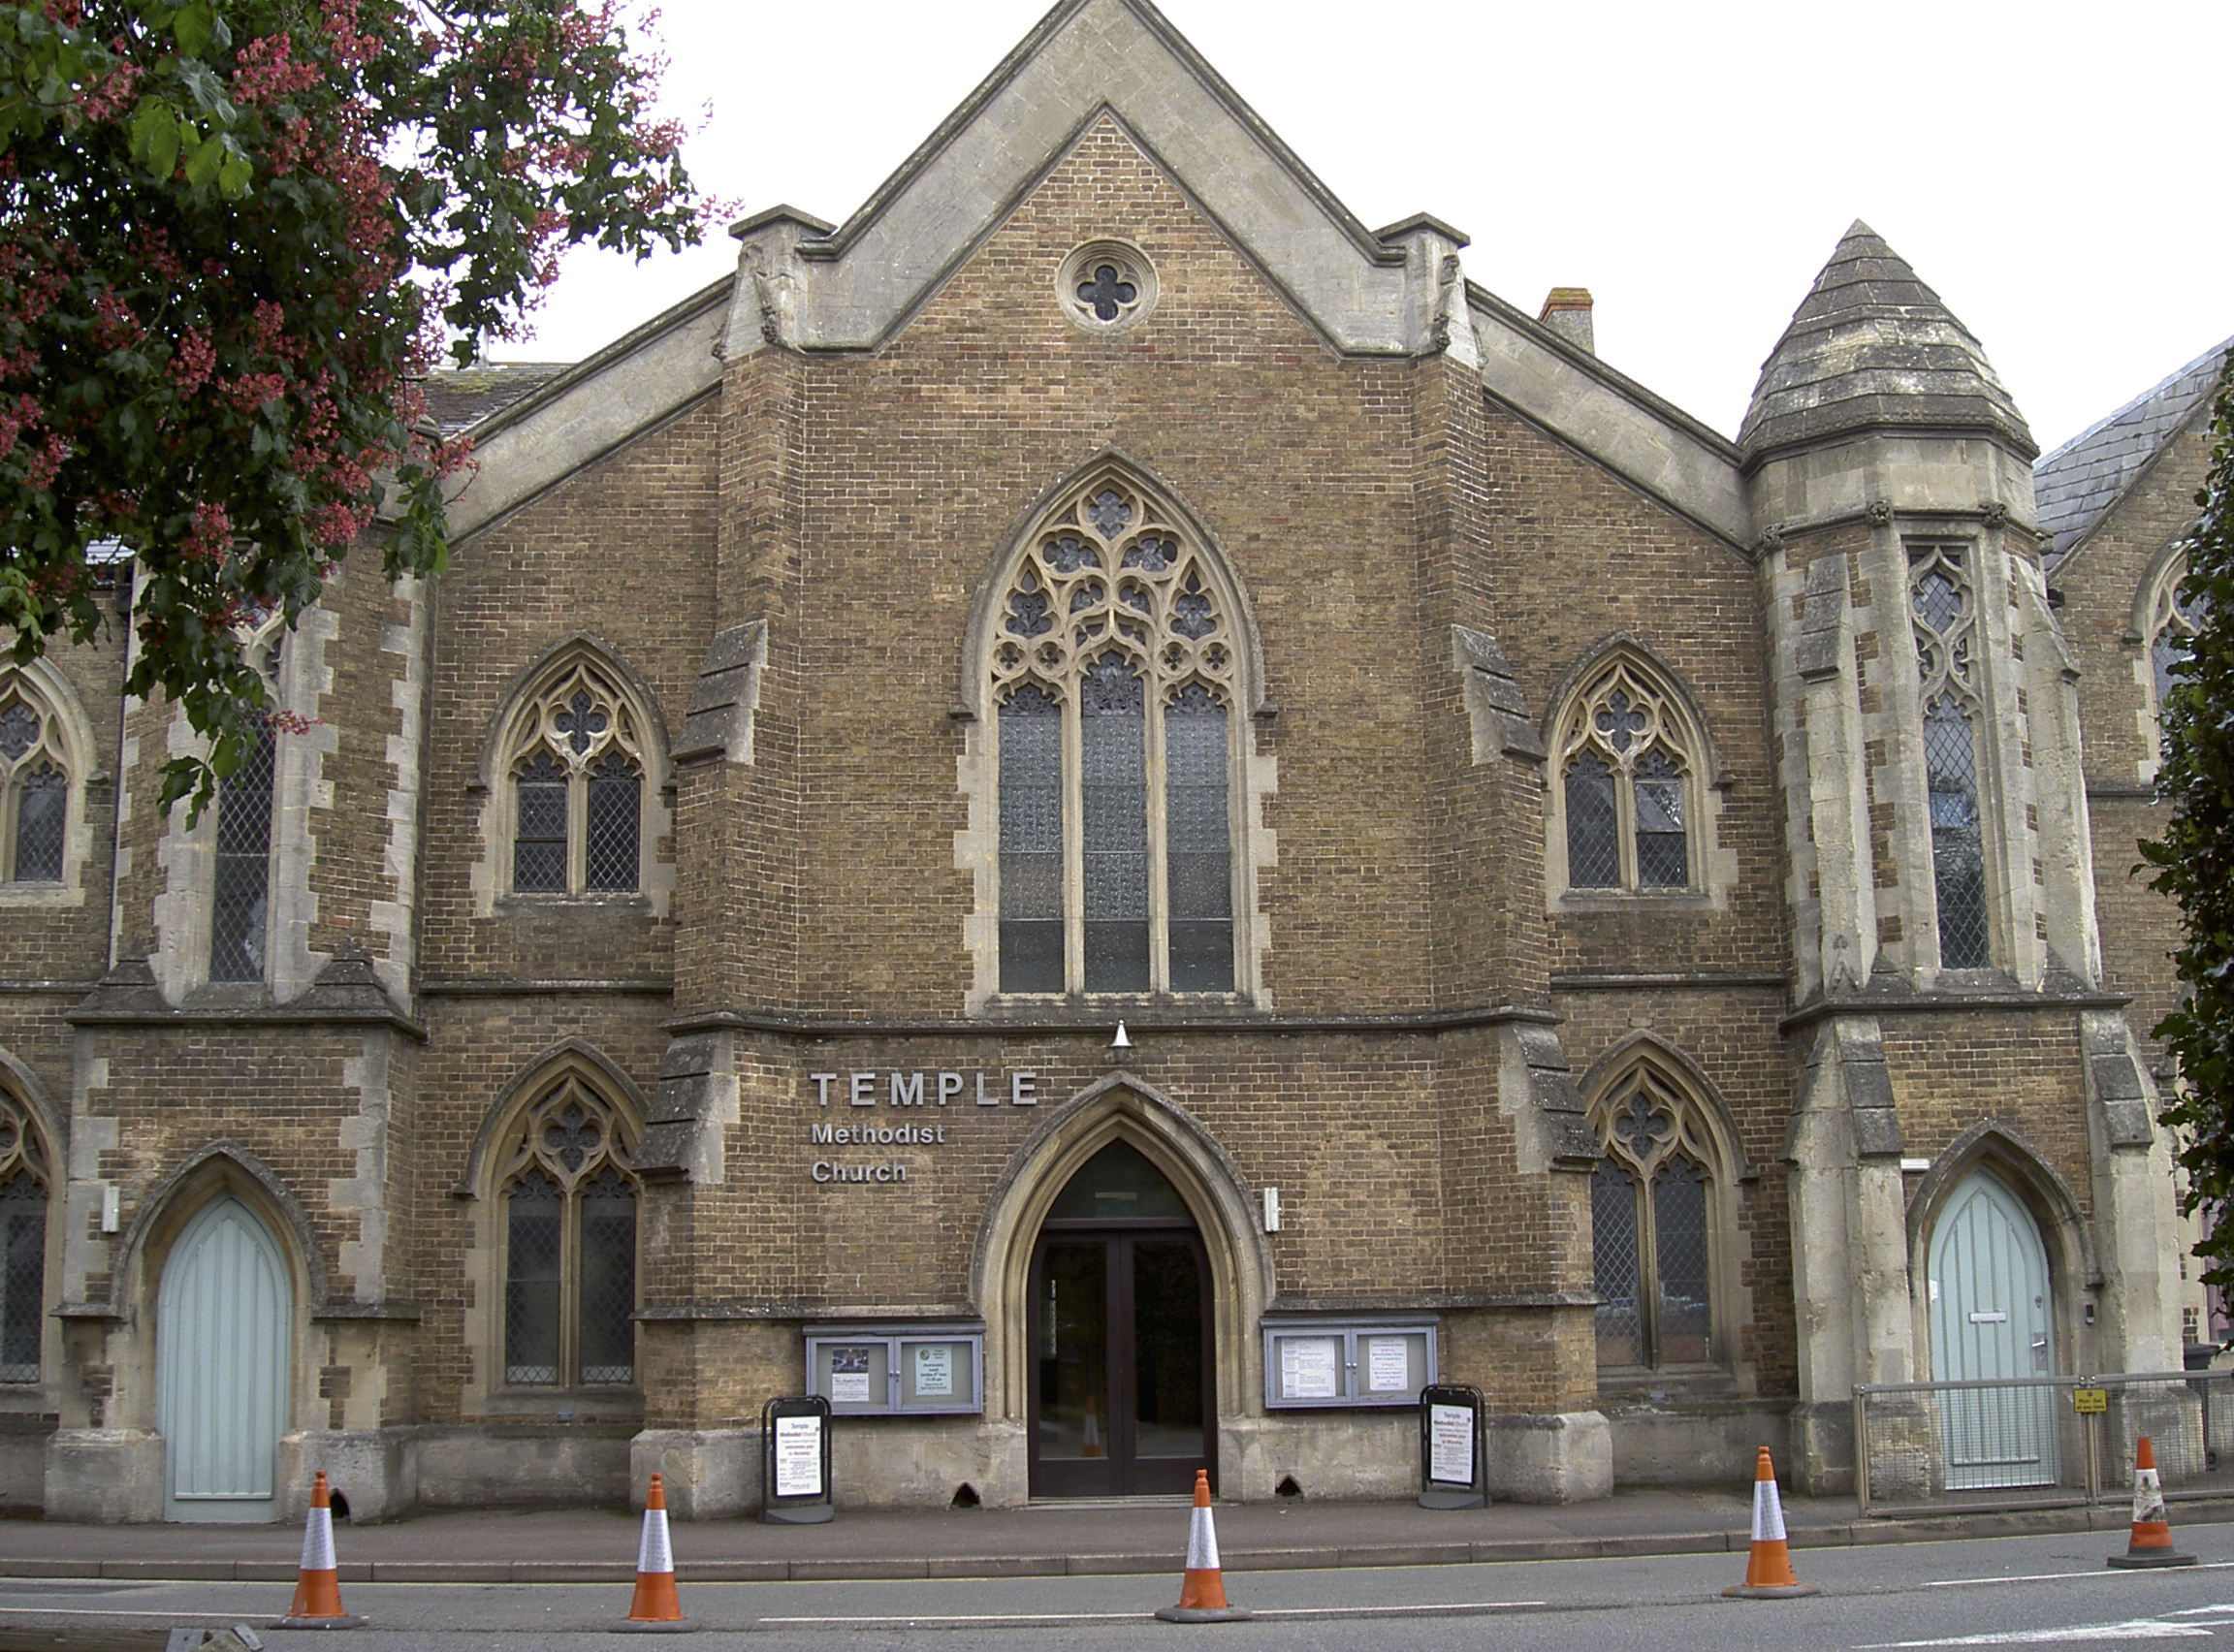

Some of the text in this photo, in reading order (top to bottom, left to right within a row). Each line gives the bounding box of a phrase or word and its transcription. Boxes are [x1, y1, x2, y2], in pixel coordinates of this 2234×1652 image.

[811, 1072, 1037, 1105] TEMPLE
[812, 1123, 945, 1144] Methodist
[812, 1160, 907, 1183] Church
